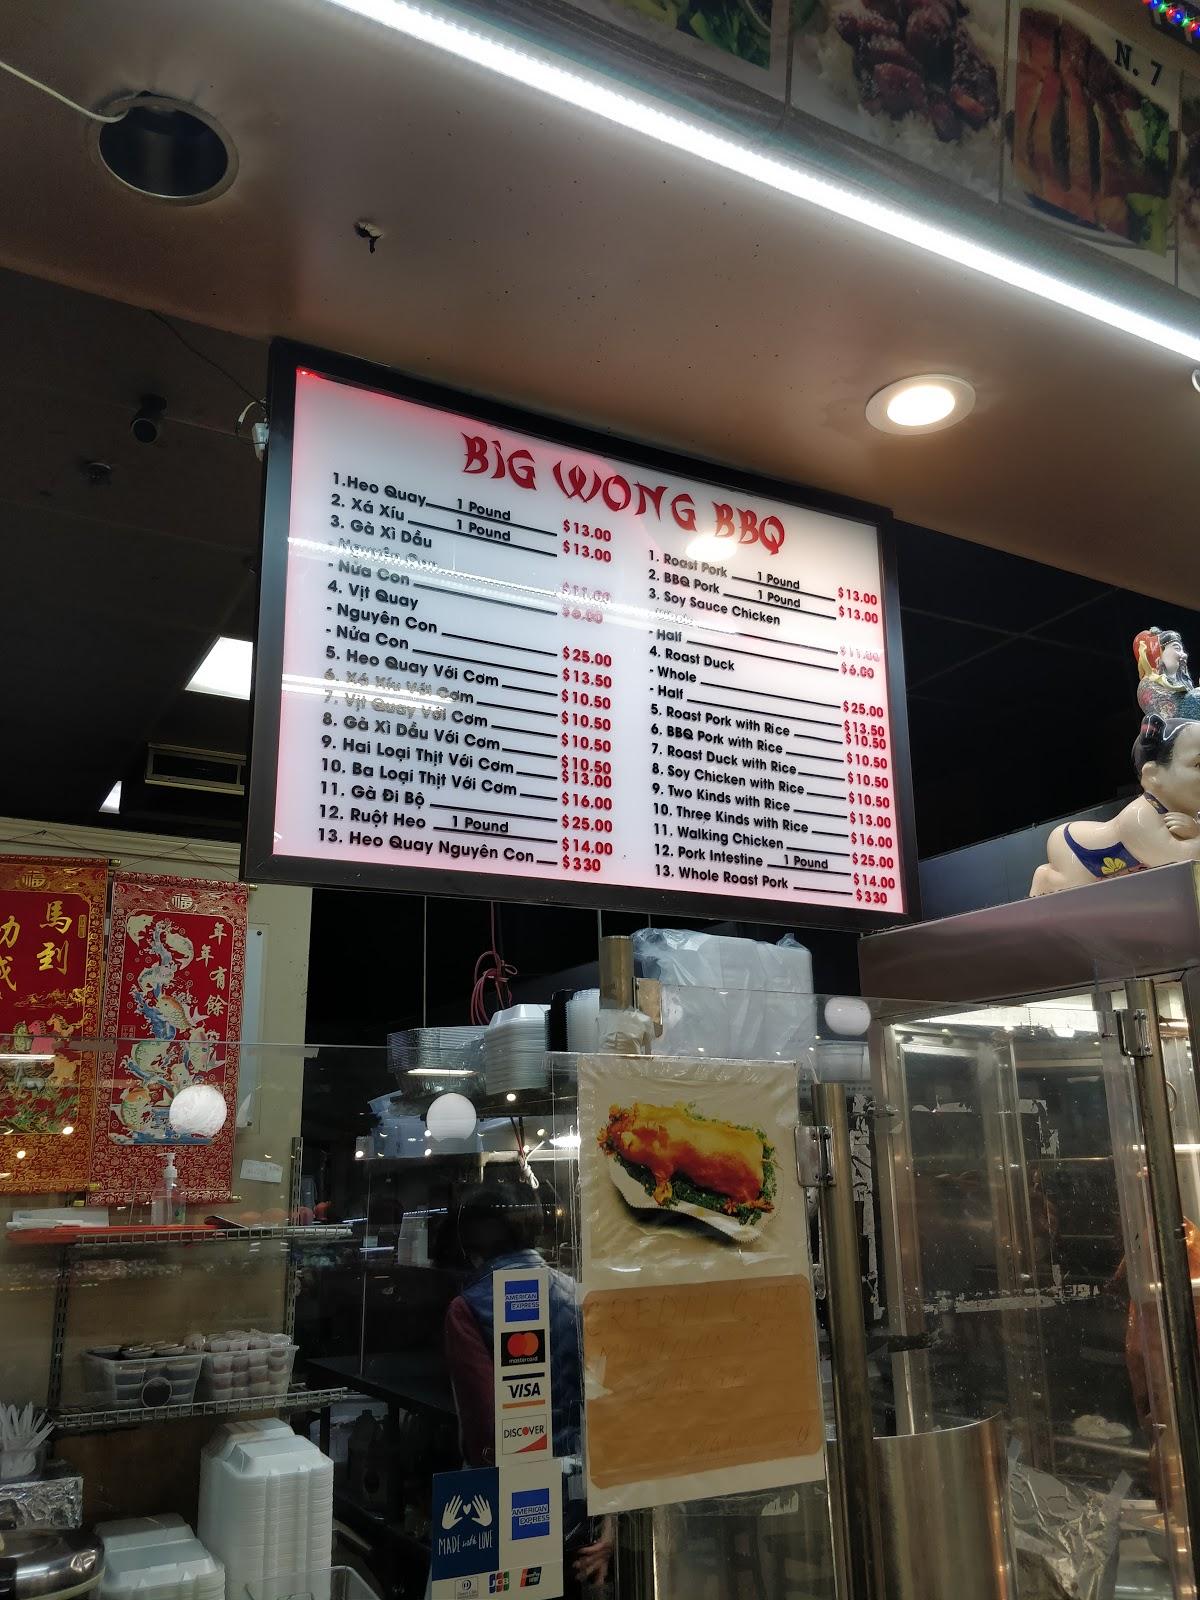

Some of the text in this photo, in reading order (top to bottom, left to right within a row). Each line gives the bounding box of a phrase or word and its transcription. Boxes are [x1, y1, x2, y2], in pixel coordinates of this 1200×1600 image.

[1115, 39, 1162, 86] N. 7
[351, 497, 612, 563] Xá Xíu Pound $13.00
[384, 485, 427, 507] Quay
[469, 501, 511, 521] Pound
[563, 519, 612, 542] $13.00
[552, 461, 699, 532] WONG
[712, 501, 785, 556] BBQ
[350, 518, 432, 548] Gà Xì Dầu
[349, 582, 418, 611] Vịt Quay
[377, 568, 410, 586] Con
[664, 553, 878, 606] Roast Pork Pound $13.00
[664, 572, 879, 624] BBQ Pork Pound $13.00
[664, 590, 781, 626] Soy Sauce Chicken
[336, 625, 612, 689] Nửa Con $13.50
[337, 602, 612, 668] Nguyên Con $25.00
[657, 628, 683, 642] Half
[346, 648, 612, 710] Heo Quay Với Cơm $10.50
[665, 648, 735, 671] Roast Duck
[658, 666, 884, 718] Whole $25.00
[658, 685, 885, 738] Half $13.50
[452, 710, 612, 753] Cơm $10.50
[561, 711, 612, 731] $10.50
[666, 705, 886, 750] Roast Pork with Rice $10.50
[343, 737, 612, 789] Hai Loại Thịt Với Cơm $13.00
[344, 715, 369, 732] Gà
[374, 719, 391, 734] Xì
[434, 728, 459, 744] Với
[464, 733, 500, 750] Cơm
[561, 755, 612, 775] $10.50
[667, 725, 888, 769] BBQ Pork with Rice $10.50
[667, 745, 889, 789] Roast Duck with Rice $10.50
[321, 757, 612, 811] 10. Ba Loại Thịt Với Cơm $16.00
[667, 765, 890, 808] Soy Chicken with Rice $10.50
[667, 785, 892, 828] Two Kinds with Rice $13.00
[320, 781, 613, 833] 11. Gà Đi Bộ $25.00
[653, 803, 893, 848] 10. Three Kinds with Rice $16.00
[318, 827, 601, 872] 13. Heo Quay Nguyên Con $330
[319, 804, 613, 856] 12. Ruột Heo Pound $14.00
[654, 823, 894, 869] 11. Walking Chicken $25.00
[654, 843, 896, 889] 12. Pork Intestine Pound $14.00
[655, 863, 888, 904] 13. Whole Roast Pork $330
[505, 1293, 537, 1301] AMERICAN
[511, 1301, 539, 1309] EXPRESS
[508, 1382, 541, 1399] VISA
[503, 1424, 544, 1439] DISCOVER
[512, 1504, 548, 1516] AMERICAN
[520, 1514, 549, 1525] EXPRESS
[438, 1535, 461, 1556] MADE
[479, 1530, 493, 1550] LOVE
